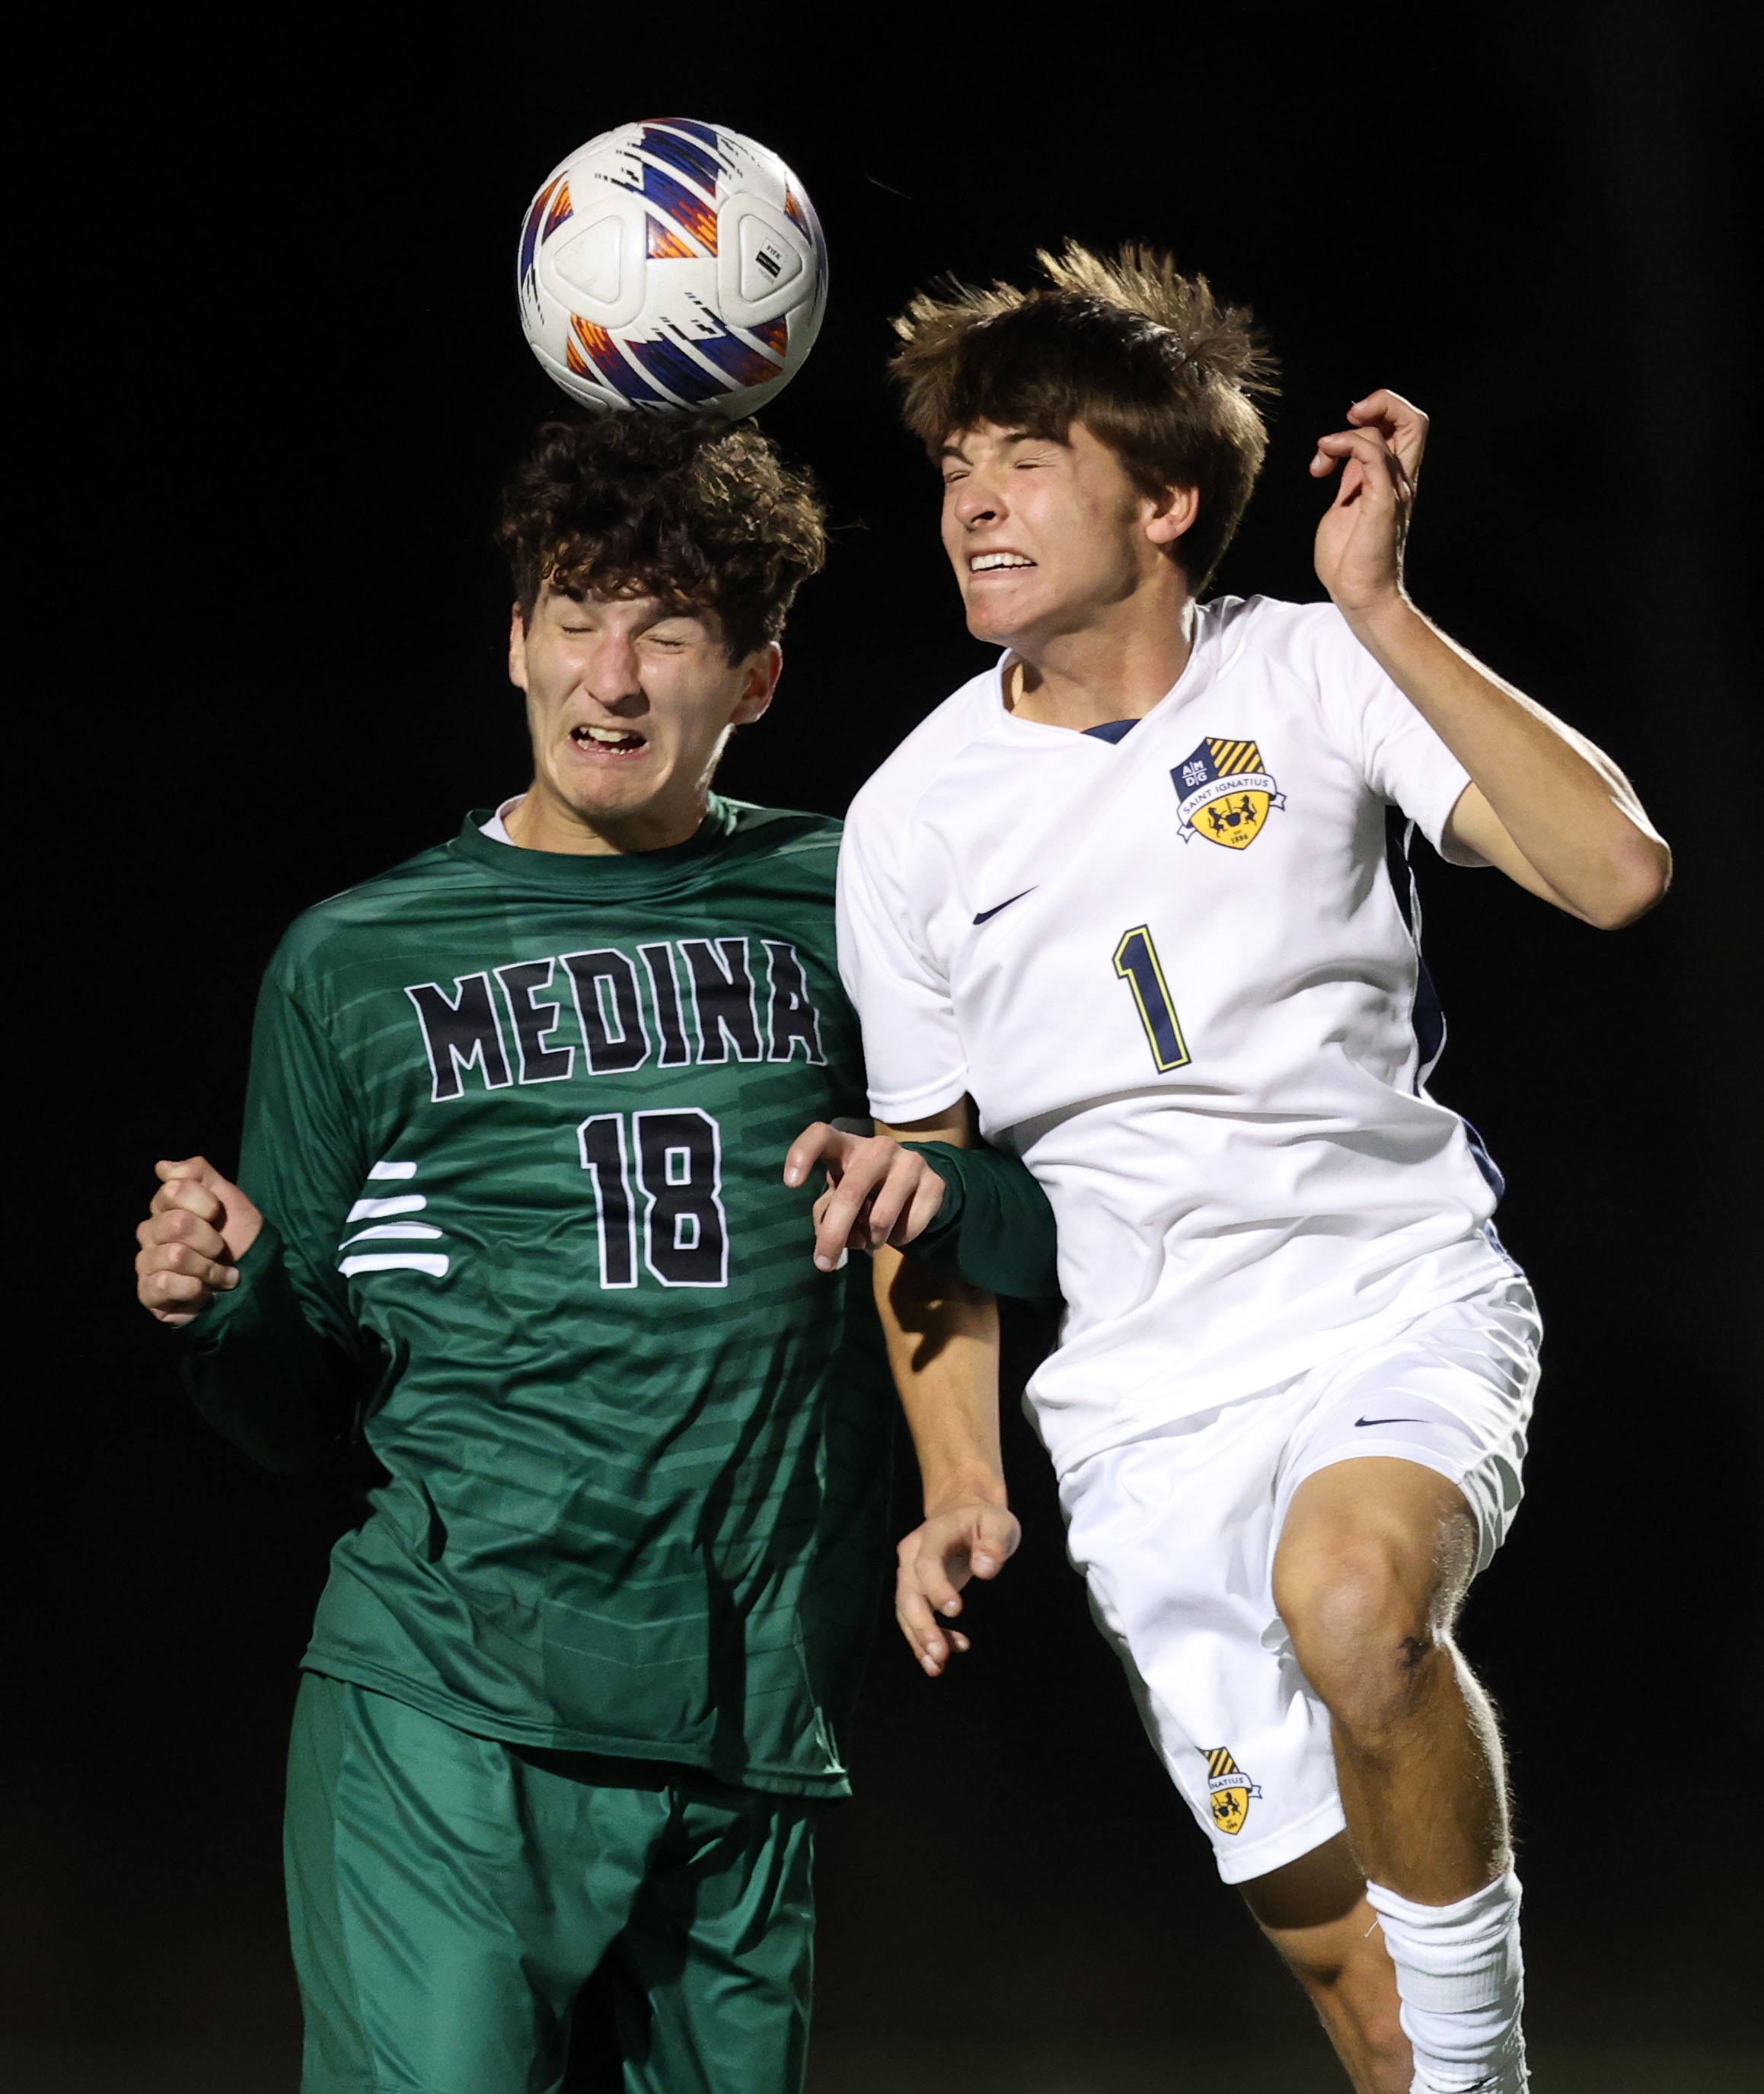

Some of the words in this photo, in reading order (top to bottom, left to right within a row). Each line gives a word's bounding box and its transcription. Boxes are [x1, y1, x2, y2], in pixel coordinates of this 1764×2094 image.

[1183, 789, 1212, 814] SAINT
[1215, 778, 1269, 793] IGNATIUS
[404, 937, 828, 1103] MEDINA
[1112, 924, 1191, 1074] 1
[576, 1107, 729, 1289] 18
